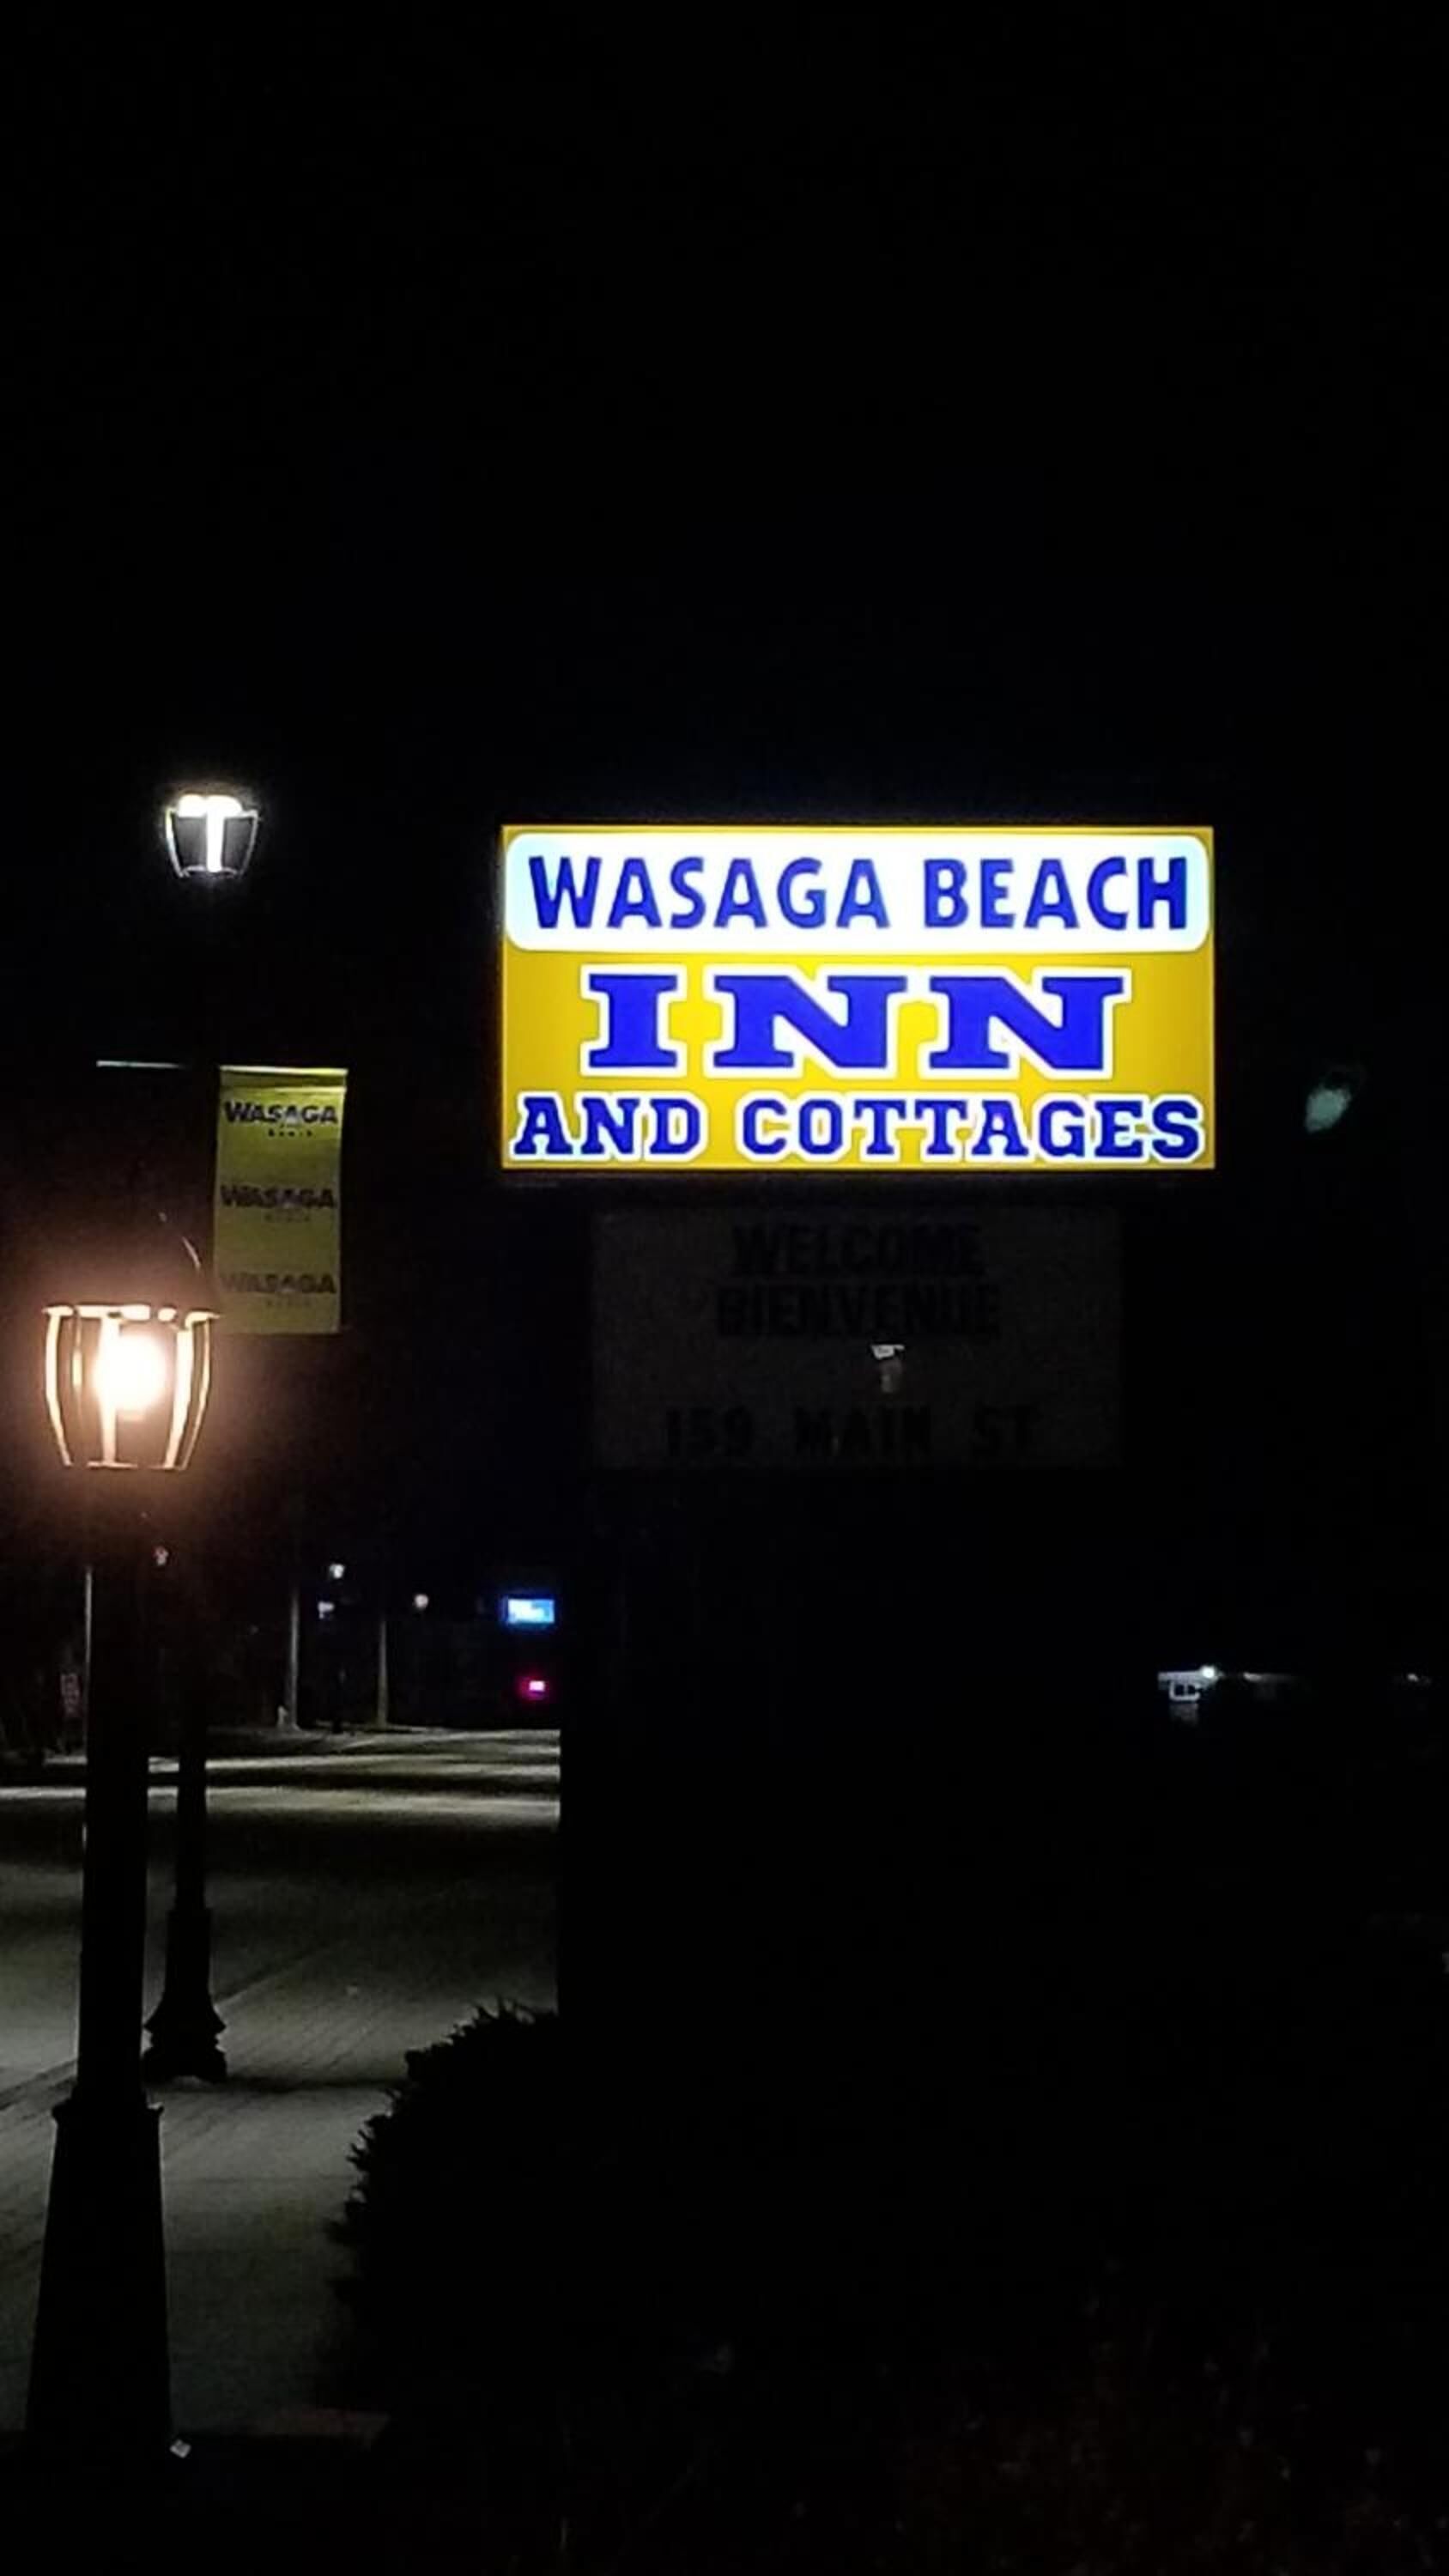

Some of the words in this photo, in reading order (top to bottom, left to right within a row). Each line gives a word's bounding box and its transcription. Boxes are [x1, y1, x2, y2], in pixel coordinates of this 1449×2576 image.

[528, 857, 889, 929] WASAGA
[923, 857, 1188, 929] BEACH
[588, 974, 1125, 1069] INN
[225, 1103, 337, 1124] WASAGA
[517, 1097, 702, 1156] AND
[743, 1099, 1200, 1158] COTTAGES
[221, 1186, 336, 1207] WASAGA
[734, 1225, 982, 1276] WELCOME
[718, 1286, 1001, 1337] BIENVENUE
[667, 1406, 753, 1457] 159
[795, 1406, 931, 1456] MAIN
[974, 1406, 1039, 1457] ST
